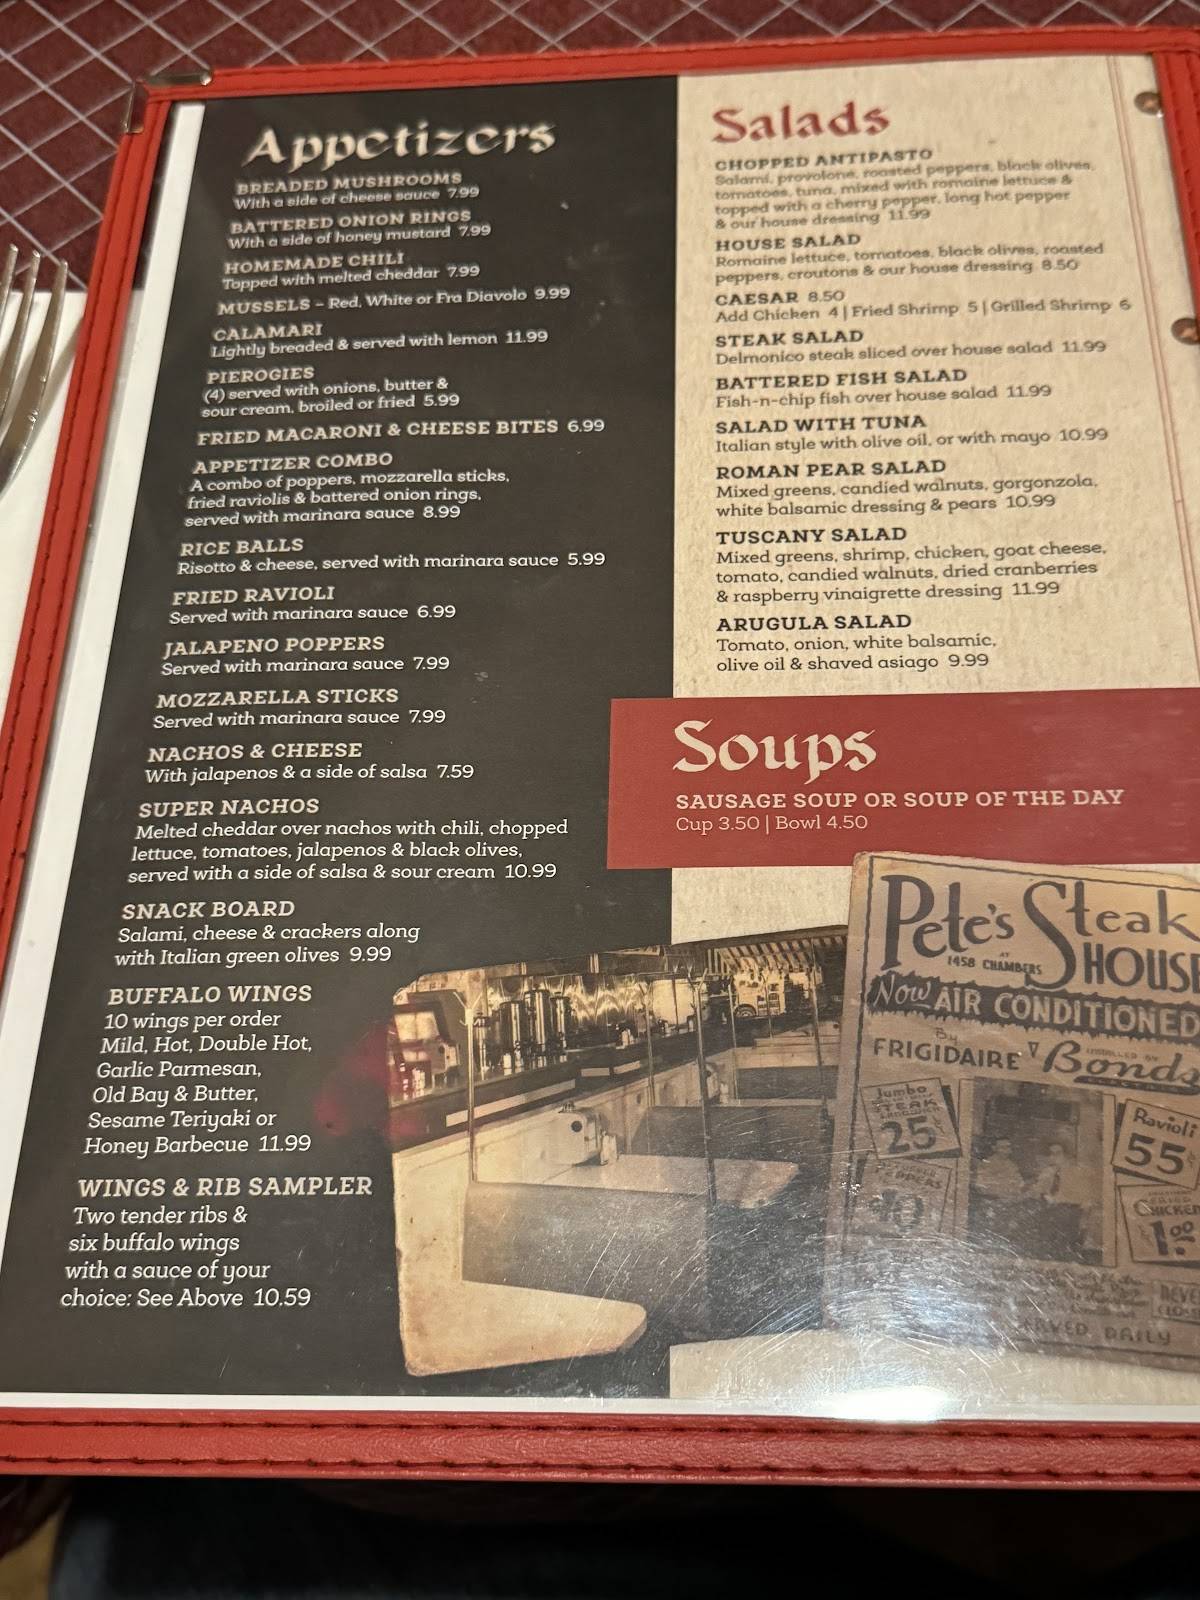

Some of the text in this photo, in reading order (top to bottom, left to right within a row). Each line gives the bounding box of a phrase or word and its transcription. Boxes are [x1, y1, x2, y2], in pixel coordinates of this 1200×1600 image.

[712, 99, 891, 144] Salads
[241, 118, 556, 174] Appetizers
[714, 147, 932, 171] CHOPPED ANTIPASTO
[237, 172, 461, 195] BREADED MUSHROOMS
[233, 185, 479, 209] With a side of cheese sauce 7.99
[230, 209, 471, 234] BATTERED ONION RINGS
[715, 232, 861, 251] HOUSE SALAD
[224, 252, 404, 274] HOMEMADE CHILI
[714, 289, 844, 306] CAESAR 8.50
[213, 323, 322, 341] CALAMARI
[715, 329, 864, 347] STEAK SALAD
[207, 366, 314, 384] PIEROGIES
[715, 368, 967, 390] BATTERED FISH SALAD
[203, 376, 448, 404] (4) served with onions, butter &
[715, 383, 1052, 409] Fish-n-chip fish over house salad 11.99
[197, 418, 605, 445] FRIED MACARONI & CHEESE BITES 6.99
[715, 414, 926, 434] SALAD WITH TUNA
[192, 451, 393, 474] APPETIZER COMBO
[716, 458, 946, 479] ROMAN PEAR SALAD
[715, 526, 907, 545] TUSCANY SALAD
[179, 537, 303, 556] RICE BALLS
[171, 585, 335, 606] FRIED RAVIOLI
[168, 604, 456, 624] Served with marinara sauce 6.99
[716, 614, 911, 632] ARUGULA SALAD
[162, 635, 384, 660] JALAPENO POPPERS
[716, 633, 996, 652] Tomato, onion, white balsamic,
[716, 652, 989, 672] olive oil & shaved asiago 9.99
[155, 687, 398, 708] MOZZARELLA STICKS
[147, 742, 362, 762] NACHOS & CHEESE
[672, 719, 877, 785] Soups
[138, 797, 319, 818] SUPER NACHOS
[675, 788, 1124, 809] SAUSAGE SOUP OR SOUP OF THE DAY
[134, 818, 568, 839] Melted cheddar over nachos with chili, chopped
[675, 814, 868, 835] Cup 3.50 Bowl 4.50
[121, 900, 295, 920] SNACK BOARD
[880, 874, 1200, 990] Pete's Steak
[115, 946, 391, 968] with Italian green olives 9.99
[948, 956, 1042, 975] 1458 CHAMBERS
[107, 984, 312, 1005] BUFFALO WINGS
[873, 974, 1200, 1038] Now AIR CONDITIONED
[104, 1009, 281, 1033] 10 wings per order
[874, 1037, 1020, 1070] FRIGIDAIRE
[96, 1060, 261, 1078] Garlic Parmesan,
[83, 1134, 311, 1159] Honey Barbecue 11.99
[77, 1176, 372, 1197] WINGS & RIB SAMPLER
[60, 1286, 311, 1306] choice: See Above 10.59
